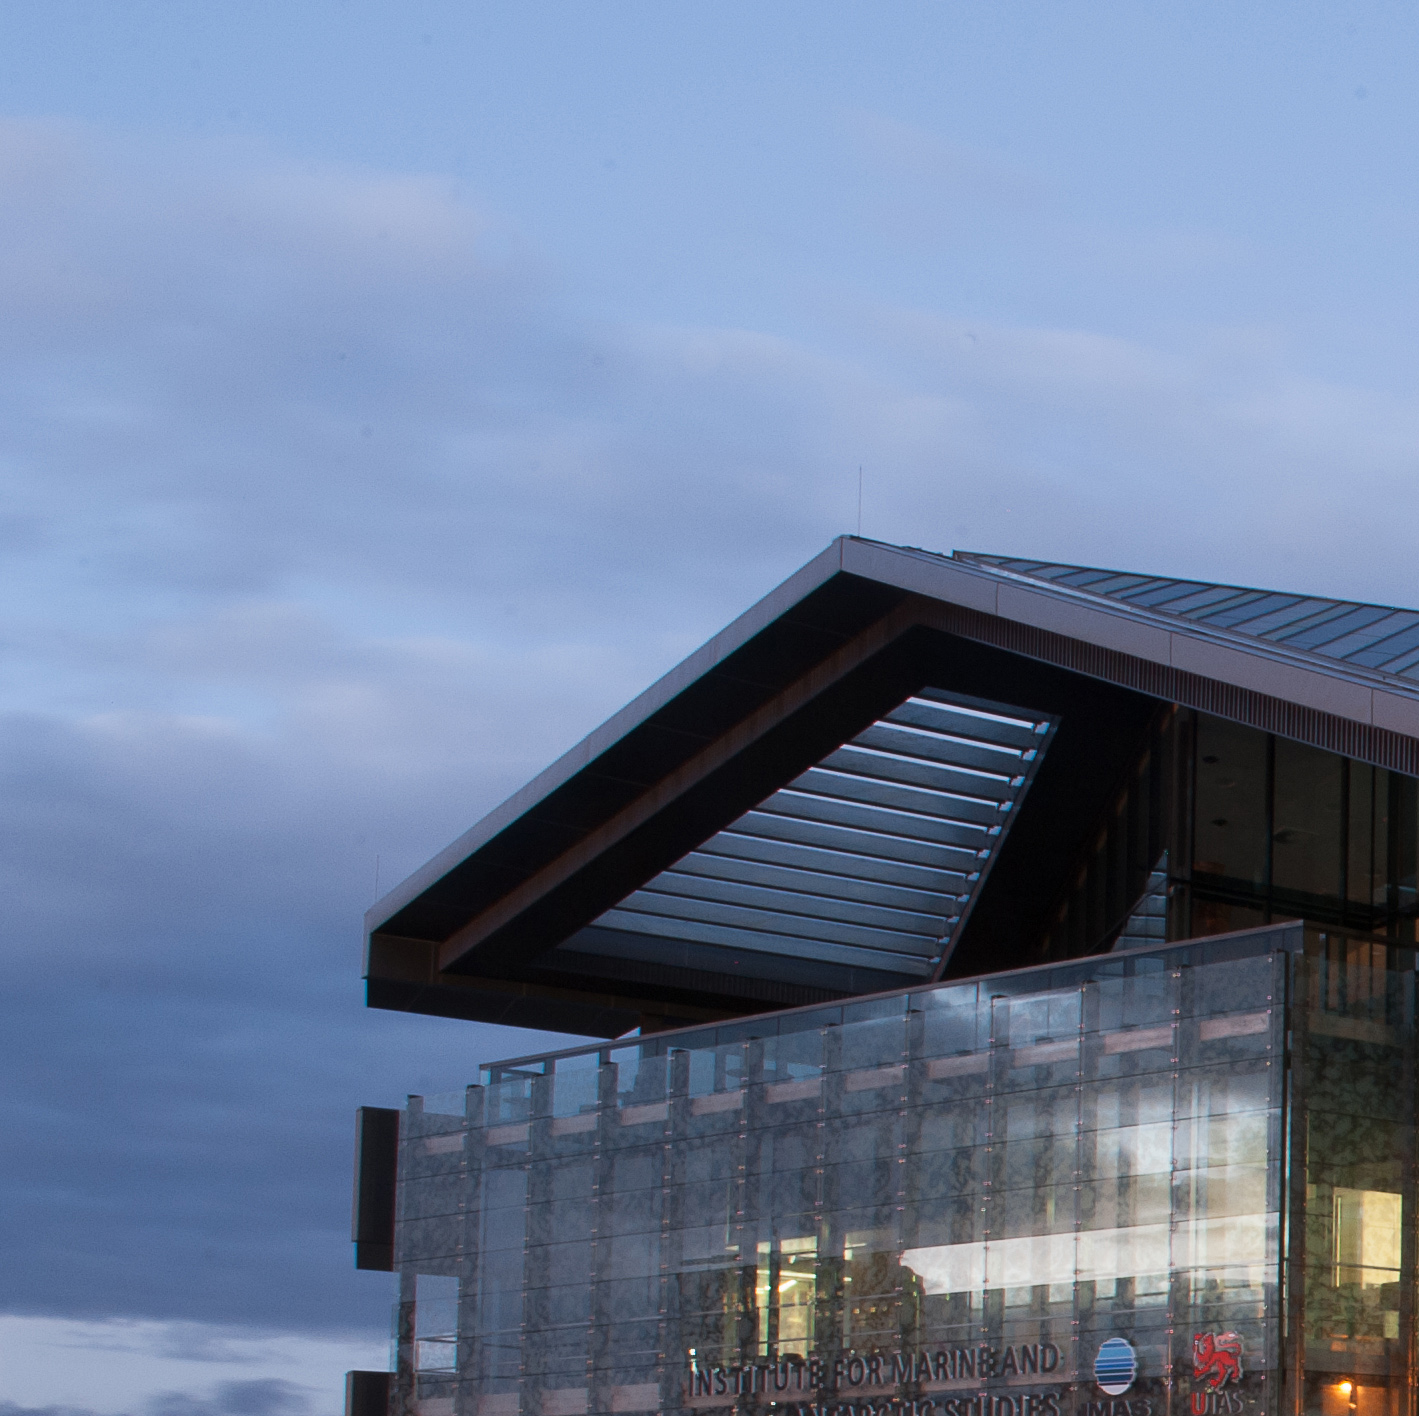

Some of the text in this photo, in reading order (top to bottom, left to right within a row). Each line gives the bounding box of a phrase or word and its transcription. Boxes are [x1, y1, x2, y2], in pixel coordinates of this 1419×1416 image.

[689, 1342, 1062, 1397] INSTITUTE FOR MARINE AND
[1191, 1391, 1244, 1416] UTAS
